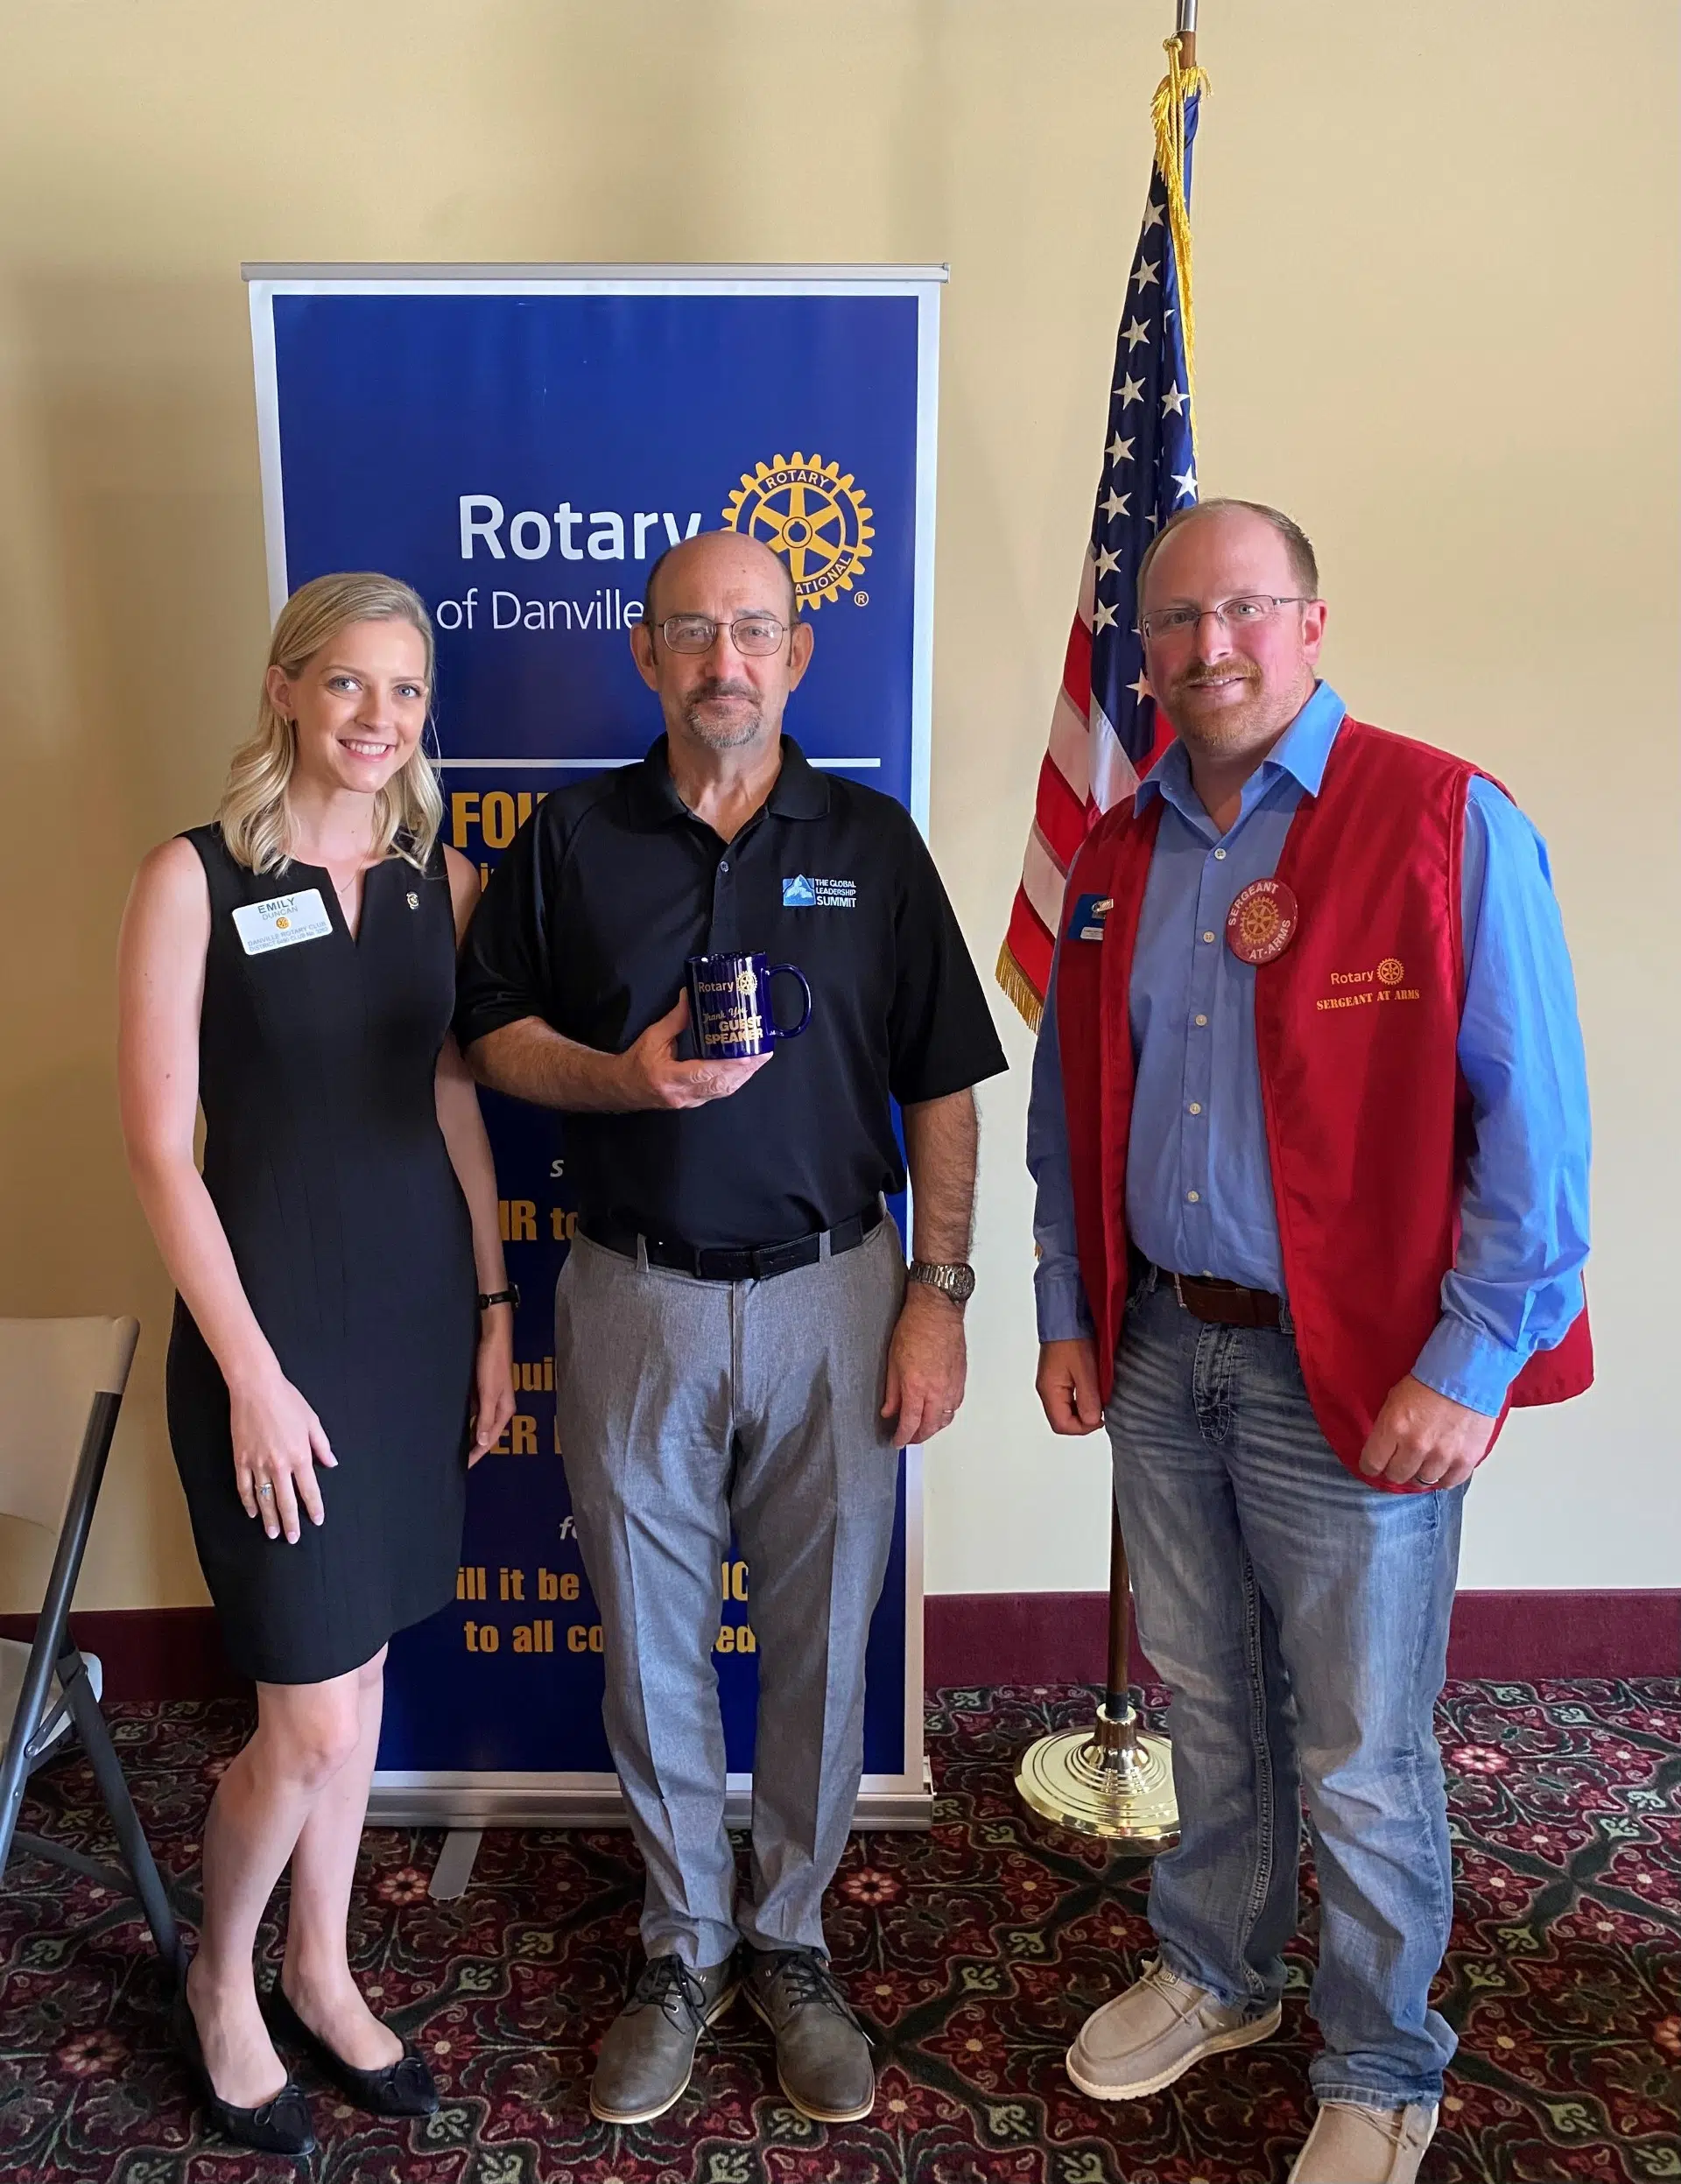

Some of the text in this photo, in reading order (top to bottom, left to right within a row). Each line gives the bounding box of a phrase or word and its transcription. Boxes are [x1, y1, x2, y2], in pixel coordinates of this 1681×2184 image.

[765, 469, 829, 489] ROTARY
[795, 557, 851, 595] ATIONAL
[437, 587, 645, 630] of Danville
[814, 878, 856, 888] THE GLOBAL
[815, 887, 856, 896] LEADERSHIP
[257, 897, 295, 914] EMILY
[816, 895, 857, 908] SUMMIT
[1227, 881, 1279, 926] SERGEANT
[262, 905, 299, 921] DUNCAN
[1331, 970, 1374, 985] Rotary
[698, 981, 735, 993] Rotary
[1316, 988, 1420, 1010] SERGEANT AT ARMS
[702, 1010, 726, 1023] Thank
[718, 1015, 763, 1031] GUEST
[704, 1028, 764, 1045] SPEAKER
[499, 1568, 525, 1601] it
[538, 1568, 580, 1601] be
[463, 1621, 500, 1653] to
[512, 1620, 553, 1653] all
